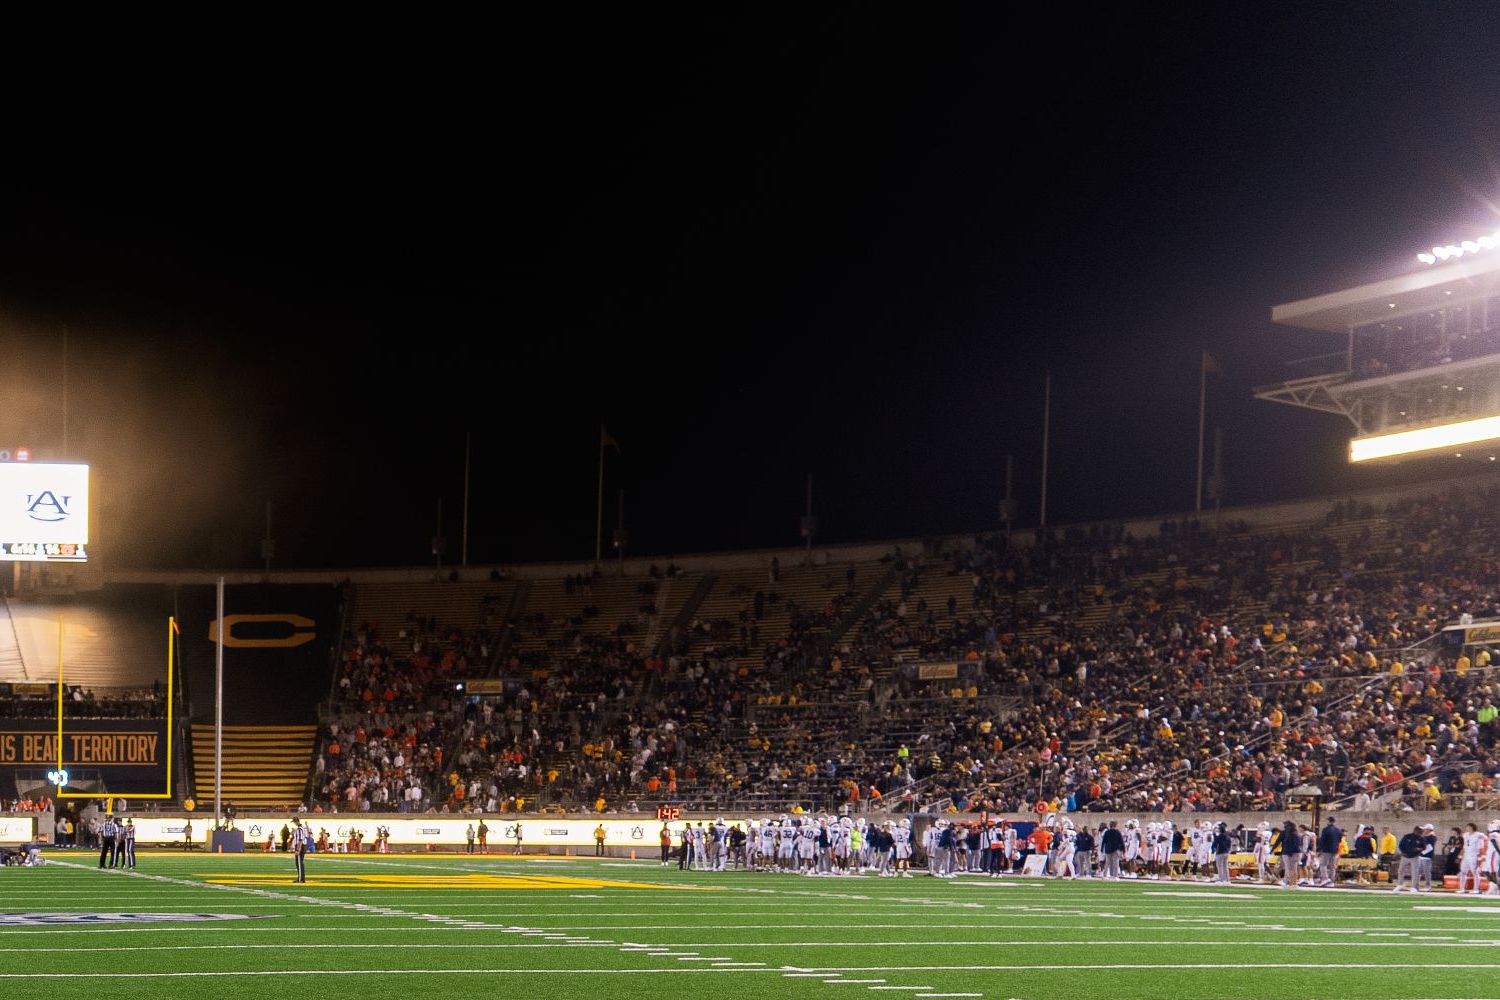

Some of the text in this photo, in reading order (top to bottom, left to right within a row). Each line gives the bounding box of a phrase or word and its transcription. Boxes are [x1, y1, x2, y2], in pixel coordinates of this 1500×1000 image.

[0, 735, 16, 761] IS
[71, 735, 158, 761] TERRITORY
[658, 808, 679, 820] 1:42
